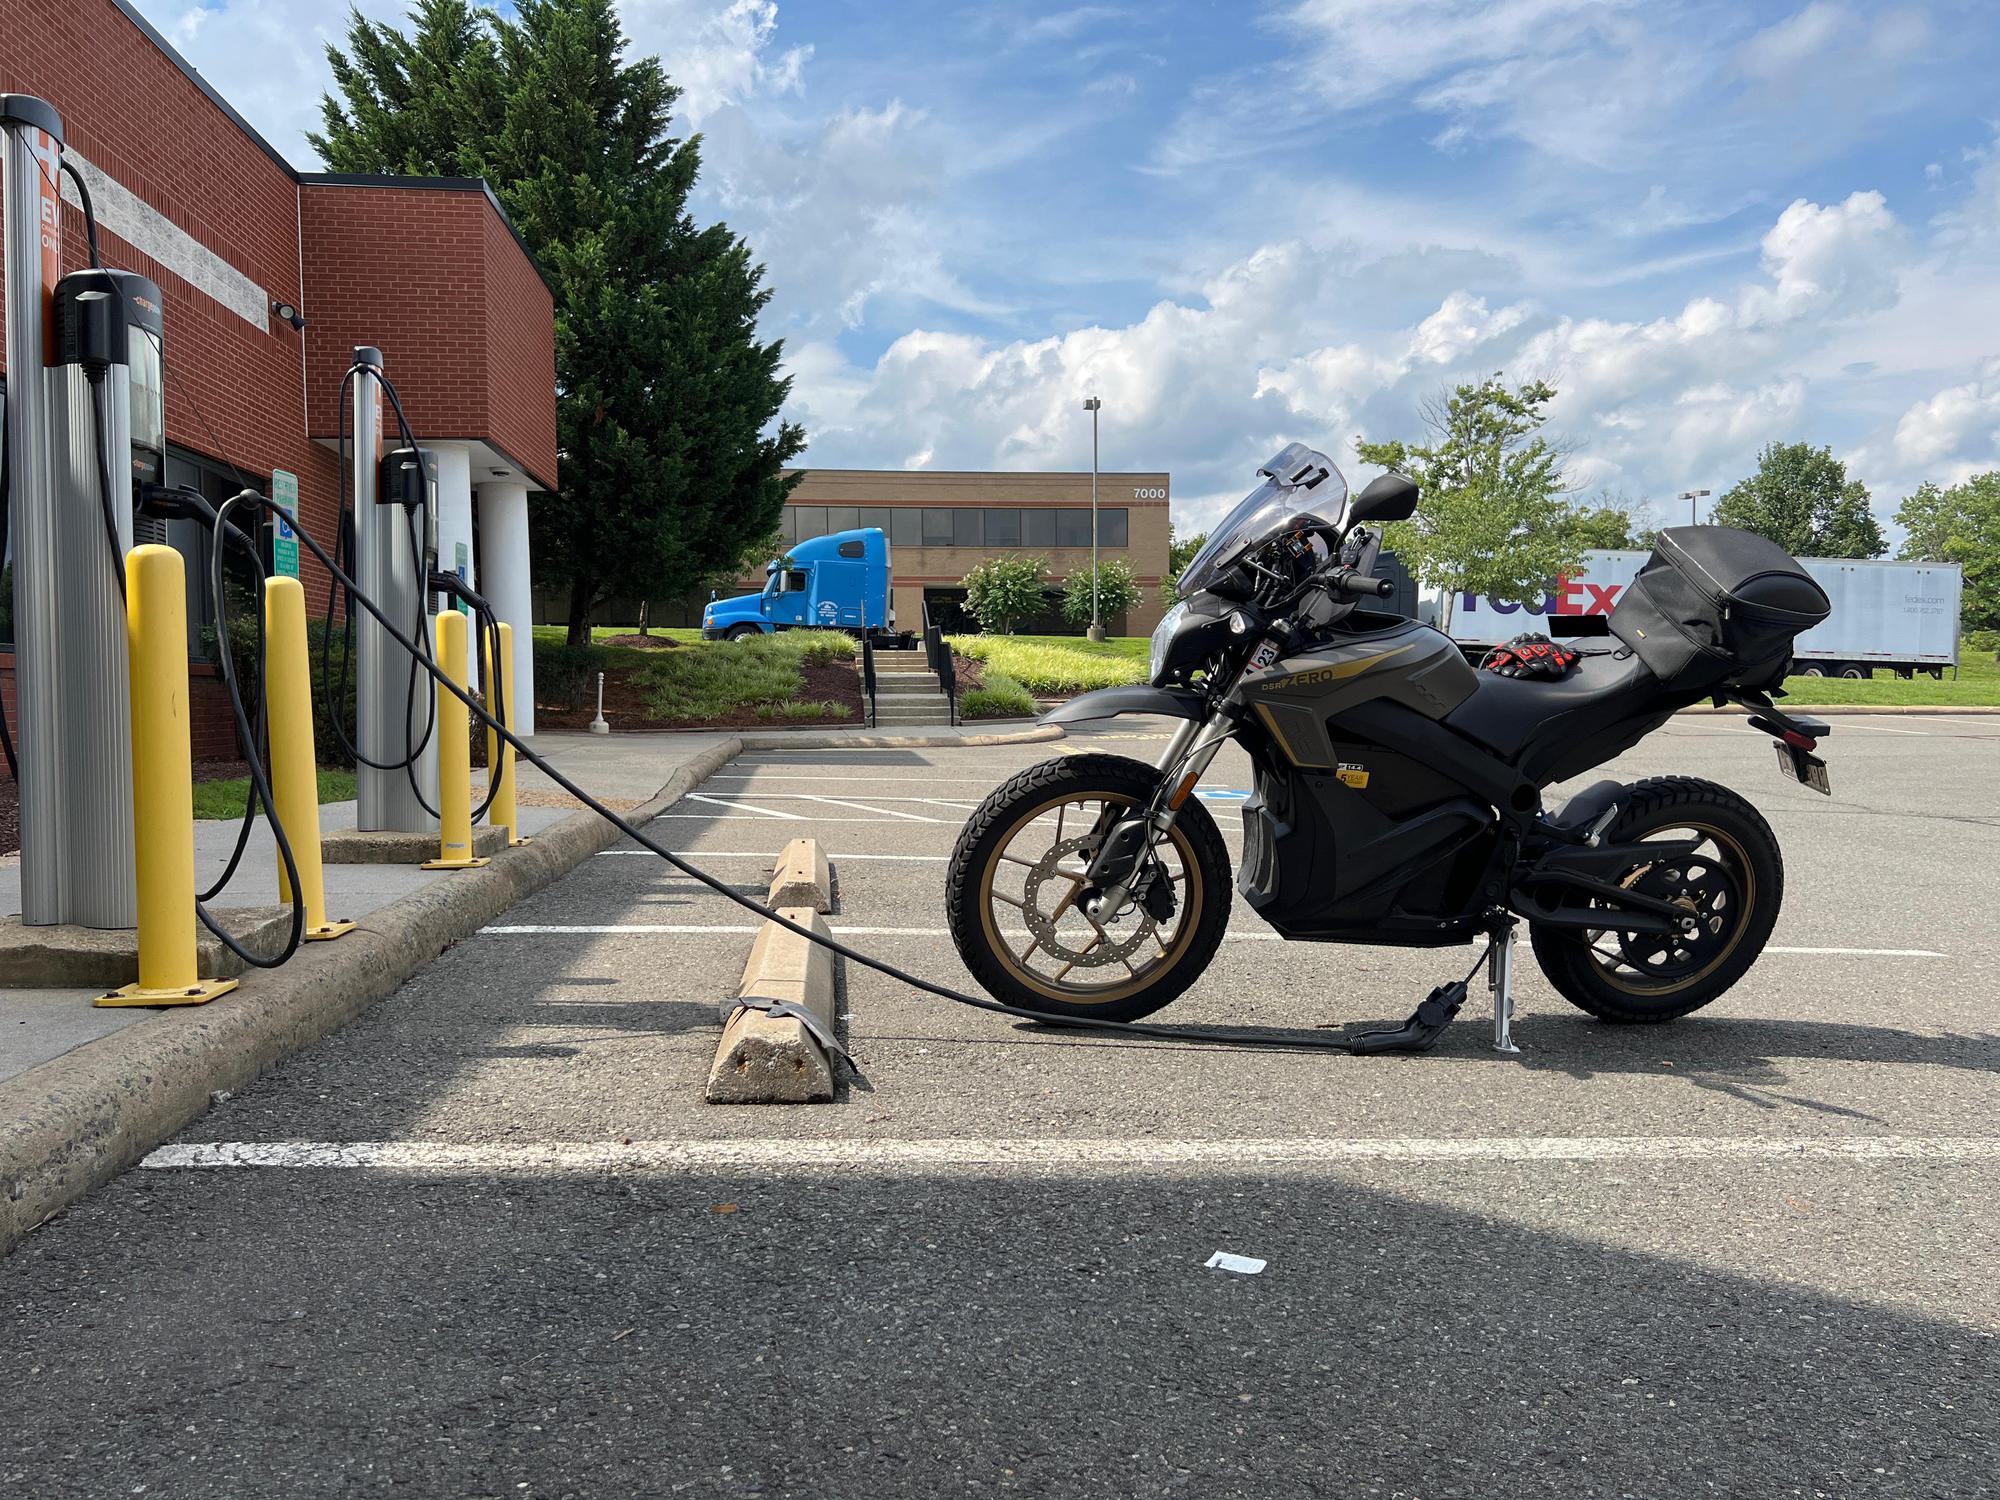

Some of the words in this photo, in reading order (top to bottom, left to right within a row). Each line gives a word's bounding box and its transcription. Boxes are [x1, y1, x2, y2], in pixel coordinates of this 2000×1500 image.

[1133, 488, 1166, 499] 7000
[1257, 648, 1275, 667] 23
[1282, 669, 1333, 688] ZERO
